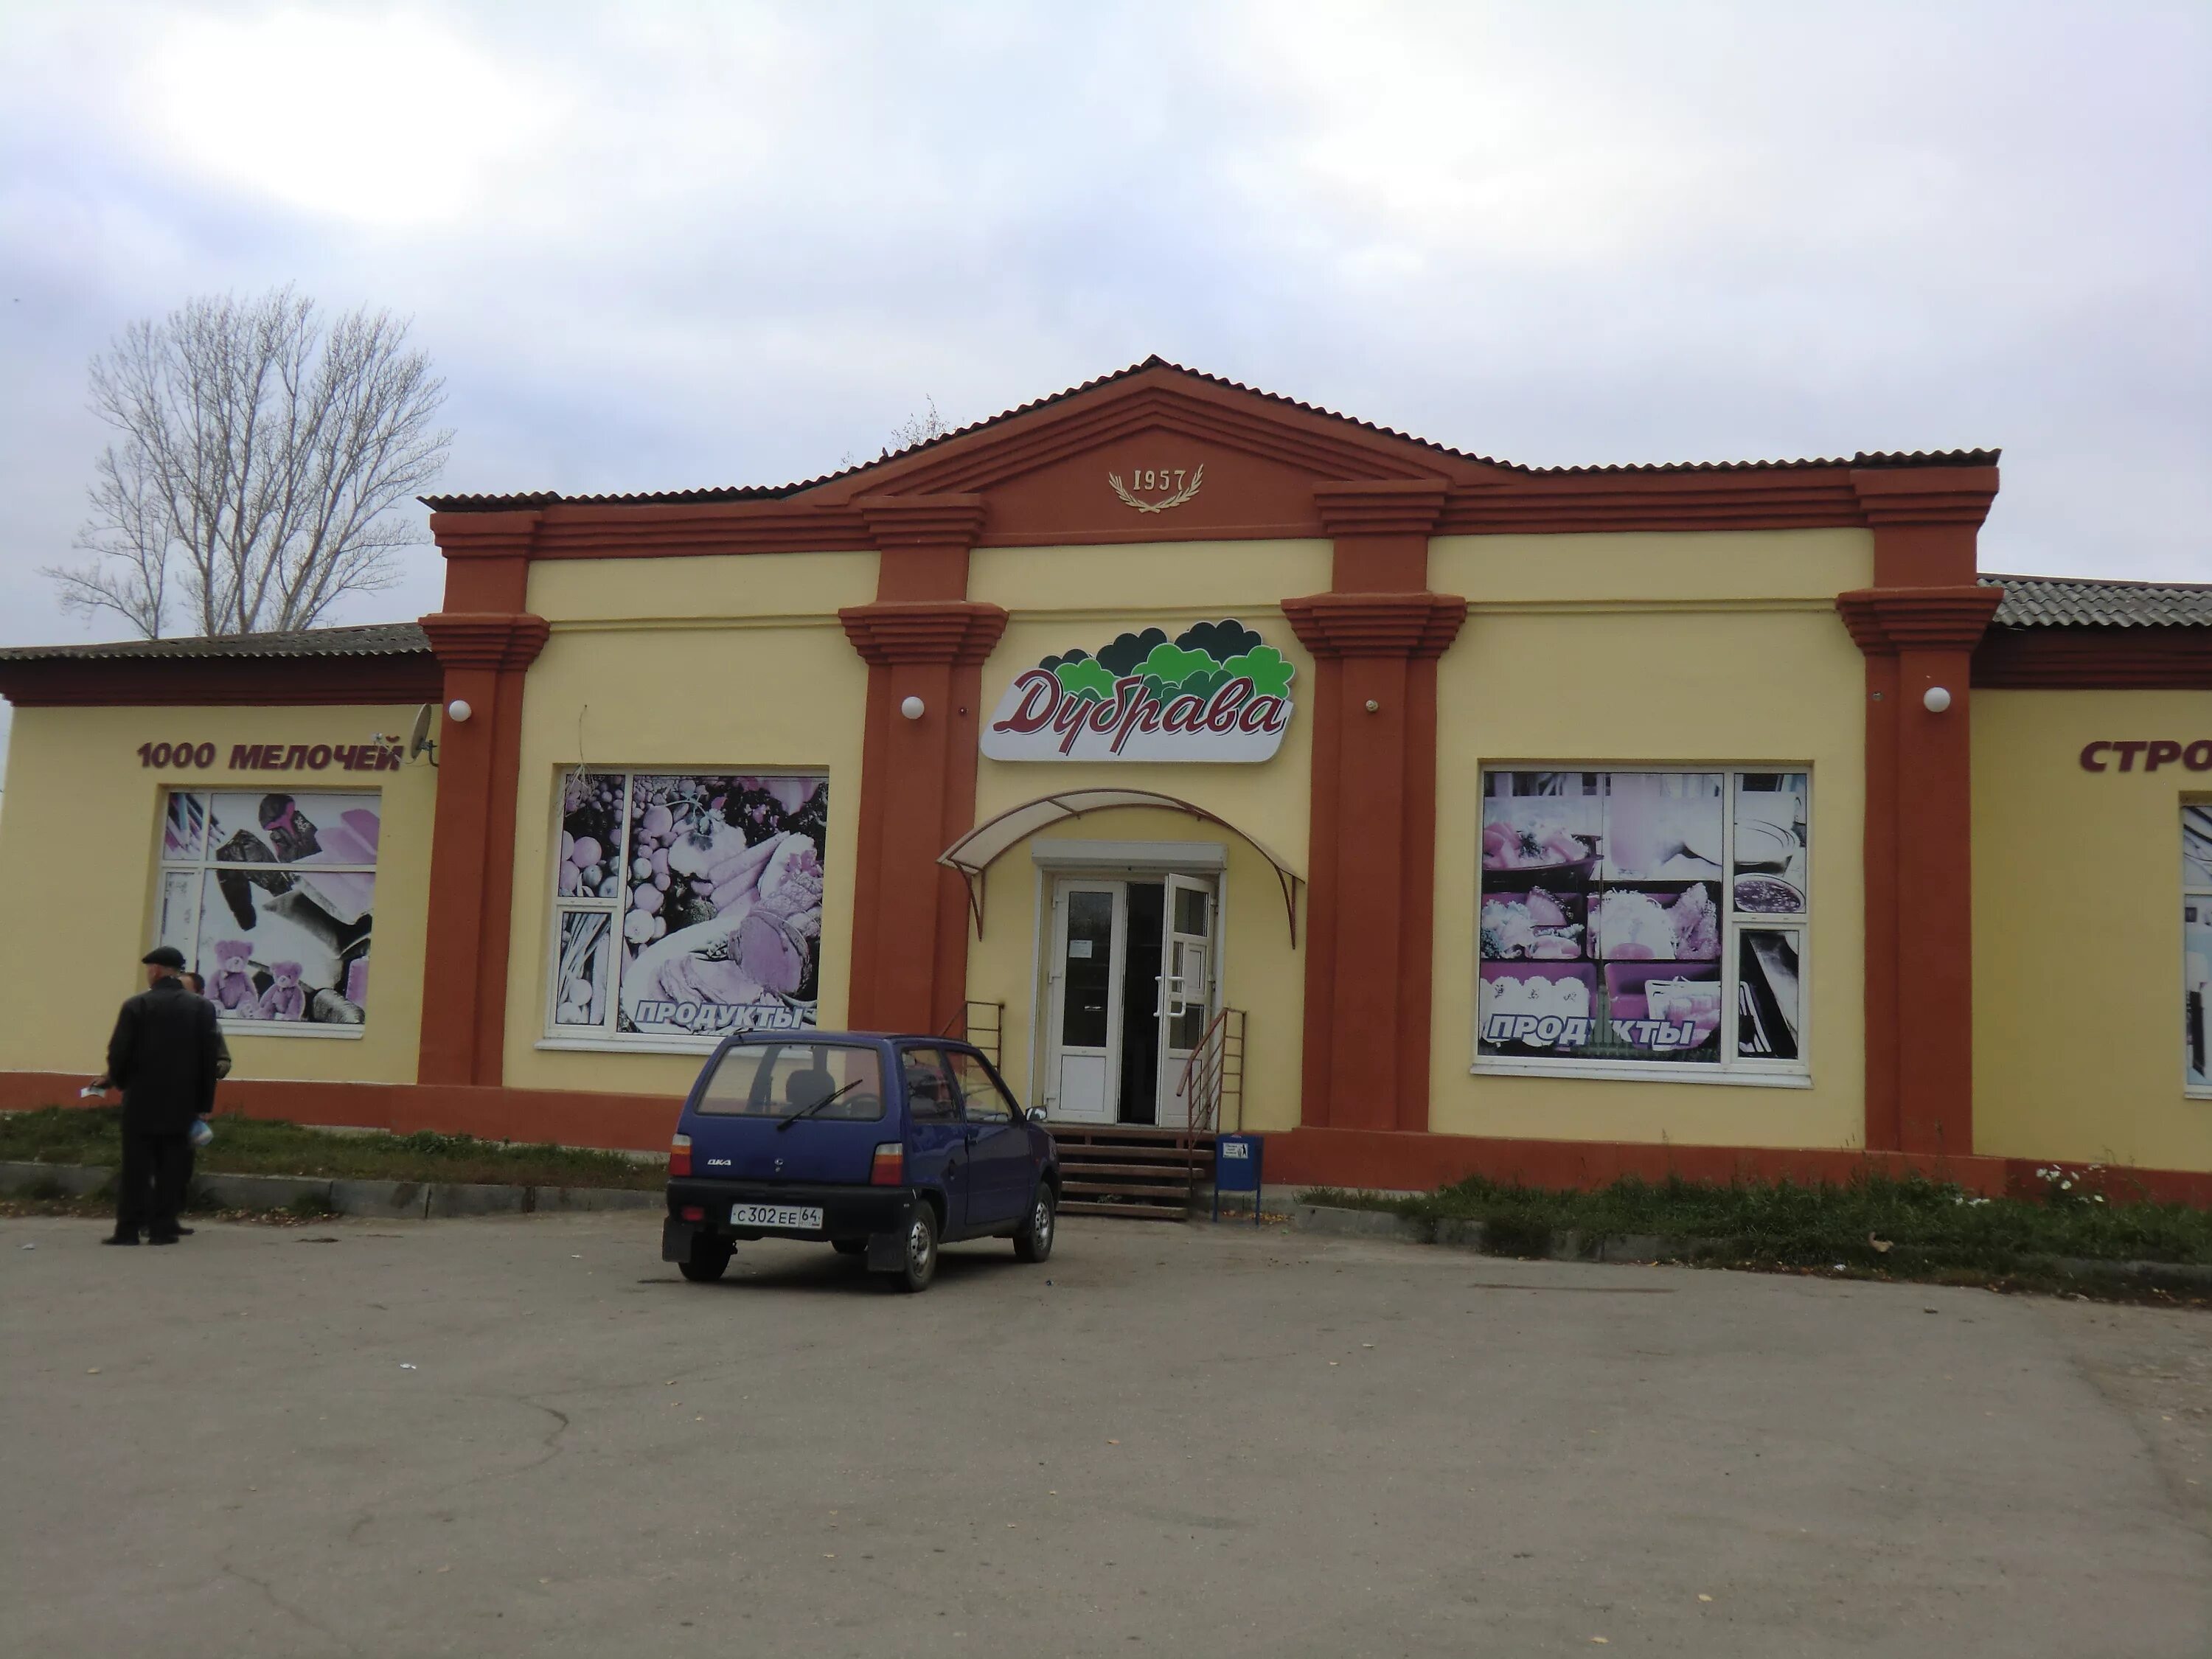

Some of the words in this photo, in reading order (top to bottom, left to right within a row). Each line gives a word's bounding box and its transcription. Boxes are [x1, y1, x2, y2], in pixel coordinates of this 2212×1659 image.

[1133, 470, 1186, 490] 1957
[992, 668, 1286, 755] Дубрава
[136, 742, 216, 769] 1000
[228, 735, 405, 771] МЕЛОЧЕЙ
[2080, 740, 2212, 773] СТРО
[635, 1000, 804, 1030] ПРОДУКТЫ
[1487, 1013, 1694, 1046] ПРОДКТЫ
[801, 1208, 818, 1222] 64
